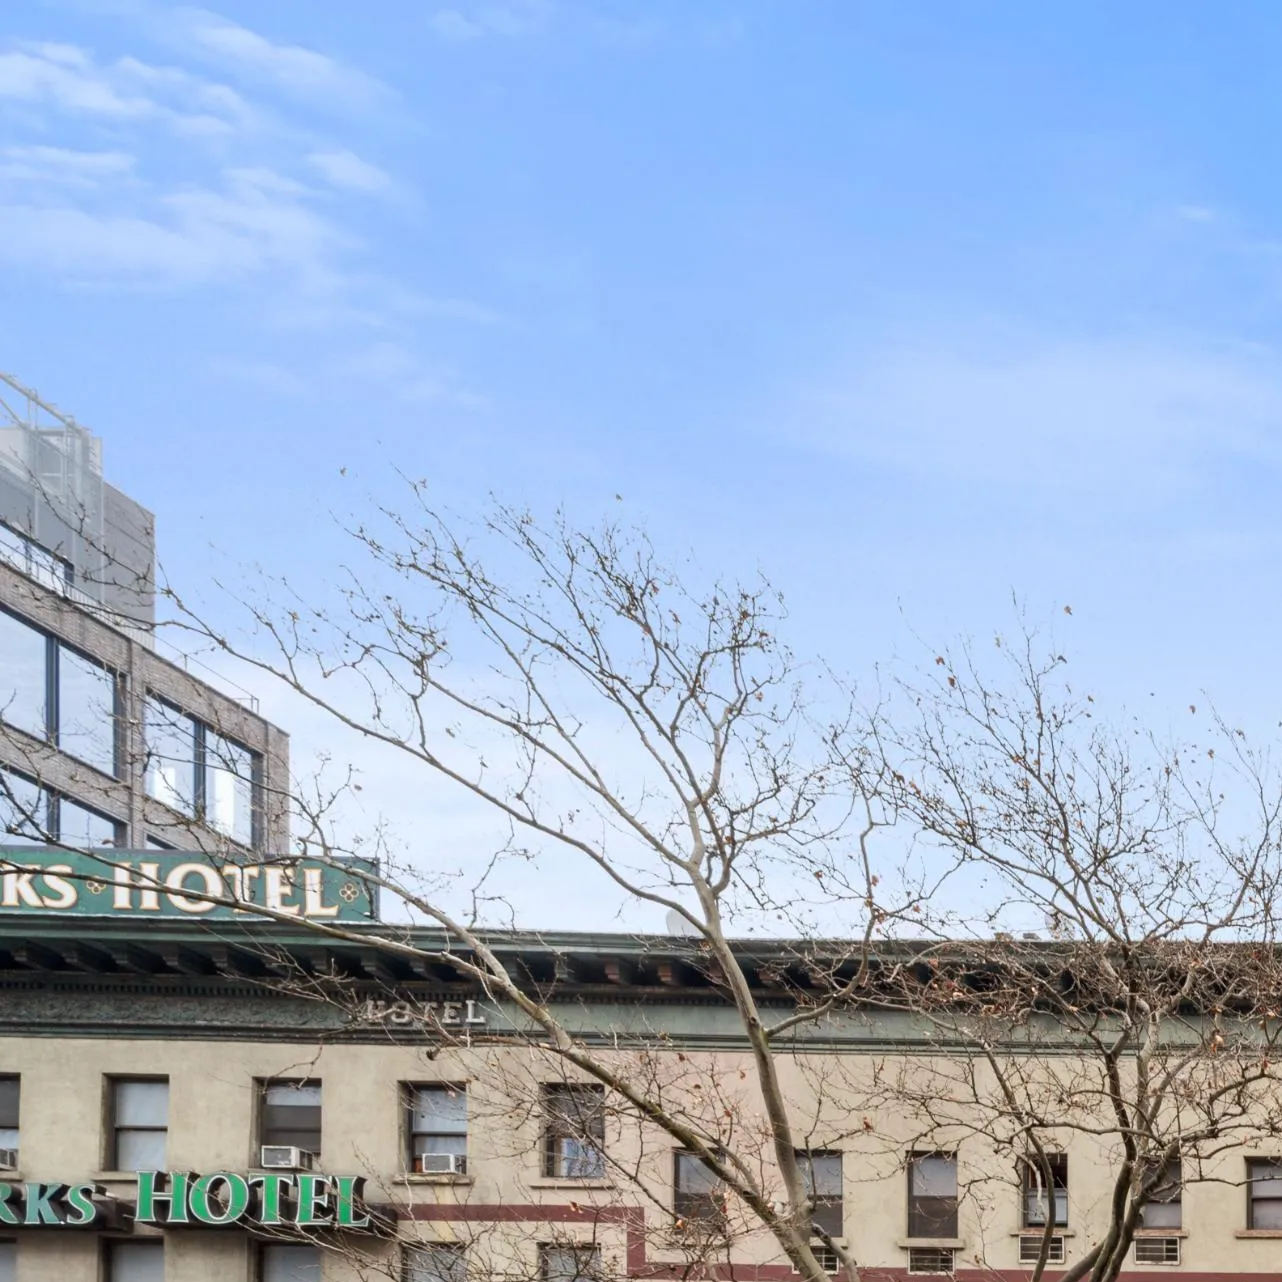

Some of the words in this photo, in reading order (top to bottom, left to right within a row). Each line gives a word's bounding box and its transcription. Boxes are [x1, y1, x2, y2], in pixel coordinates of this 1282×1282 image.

[113, 862, 340, 917] HOTEL
[366, 1000, 486, 1023] HOTEL
[136, 1171, 372, 1227] HOTEL
